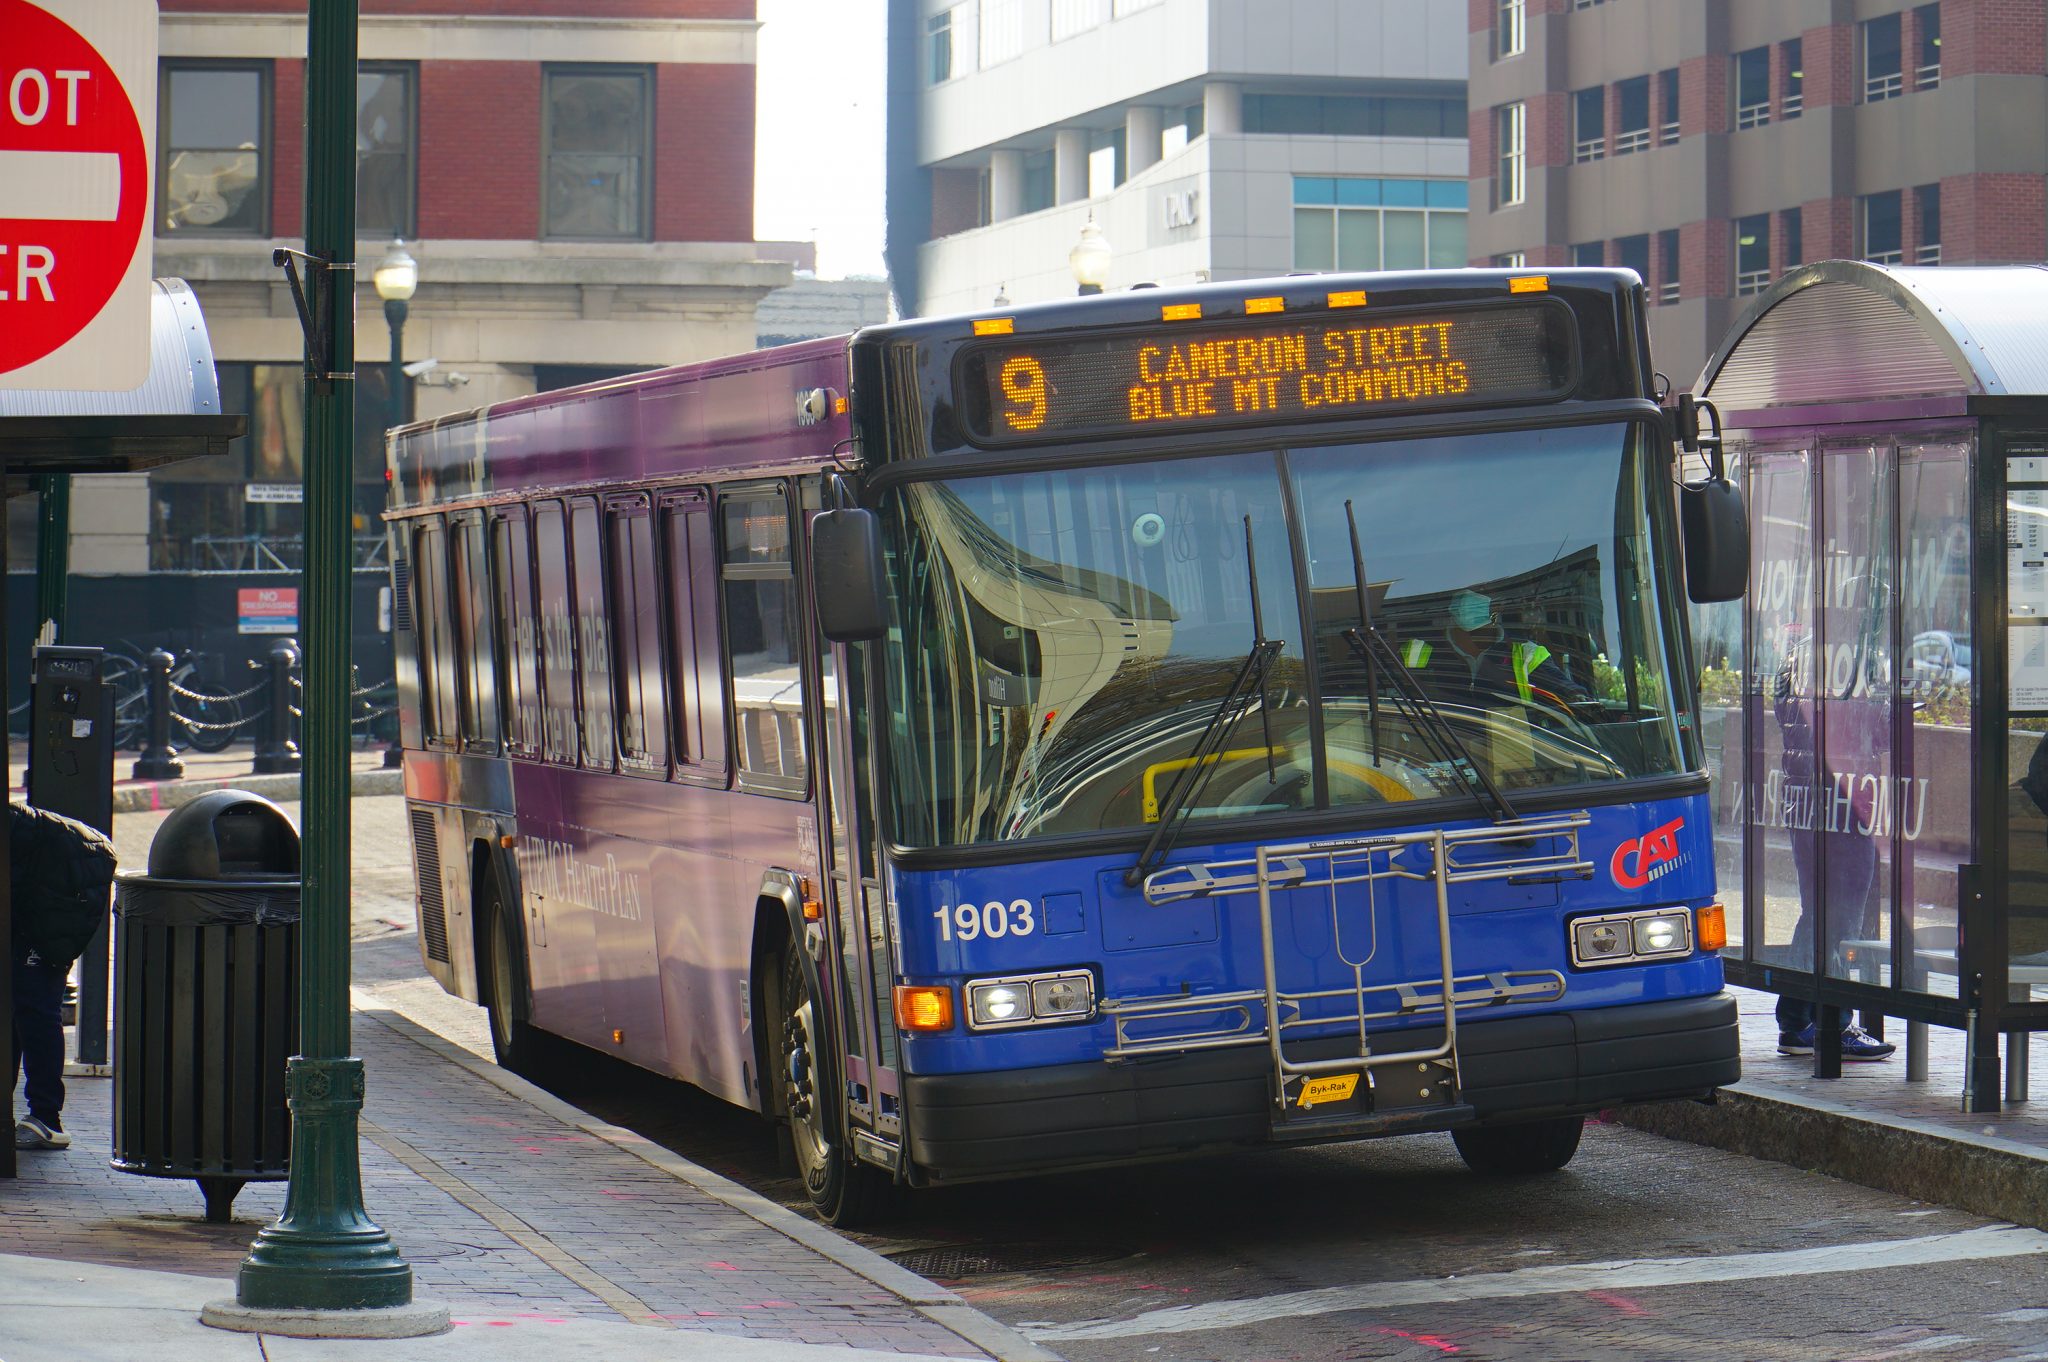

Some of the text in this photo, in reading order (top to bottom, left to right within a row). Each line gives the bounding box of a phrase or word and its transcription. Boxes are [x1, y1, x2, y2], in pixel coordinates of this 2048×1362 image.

[1139, 322, 1453, 383] CAMERON STREET
[1001, 357, 1046, 430] 9
[1129, 361, 1469, 420] BLUE MT COMMONS
[259, 591, 278, 601] NO
[525, 835, 641, 920] UPMC HEALTH PLAN
[1610, 816, 1684, 890] CAT
[933, 898, 1035, 941] 1903
[1310, 1083, 1347, 1095] Byk-Rak
